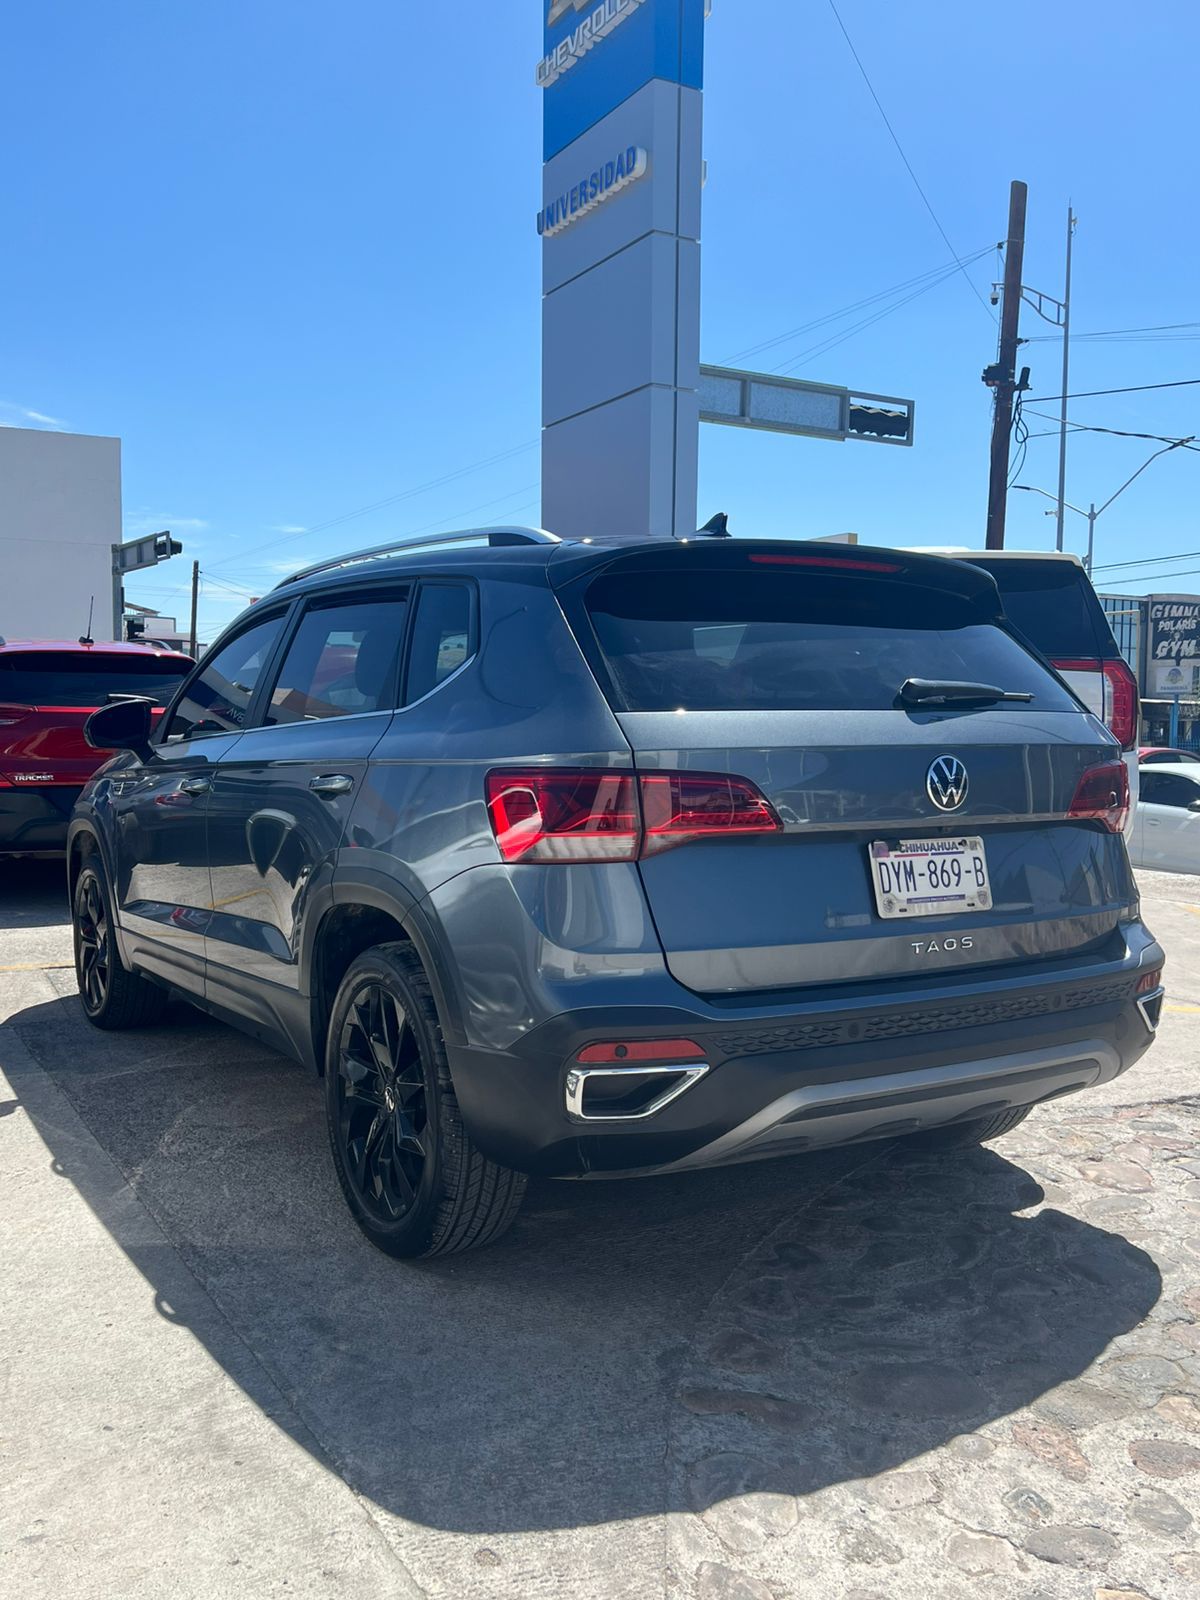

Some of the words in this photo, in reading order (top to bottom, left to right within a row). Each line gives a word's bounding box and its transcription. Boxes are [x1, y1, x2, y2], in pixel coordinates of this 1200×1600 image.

[536, 0, 642, 86] CHEVROL
[537, 146, 639, 235] UNIVERSIDAD
[1152, 603, 1200, 618] GIMNA
[1157, 618, 1197, 632] POLARIS
[1156, 639, 1196, 659] GYM
[899, 841, 959, 853] CHIHUAHUA
[878, 857, 985, 894] DYM-869-B
[912, 937, 973, 954] TAOS
